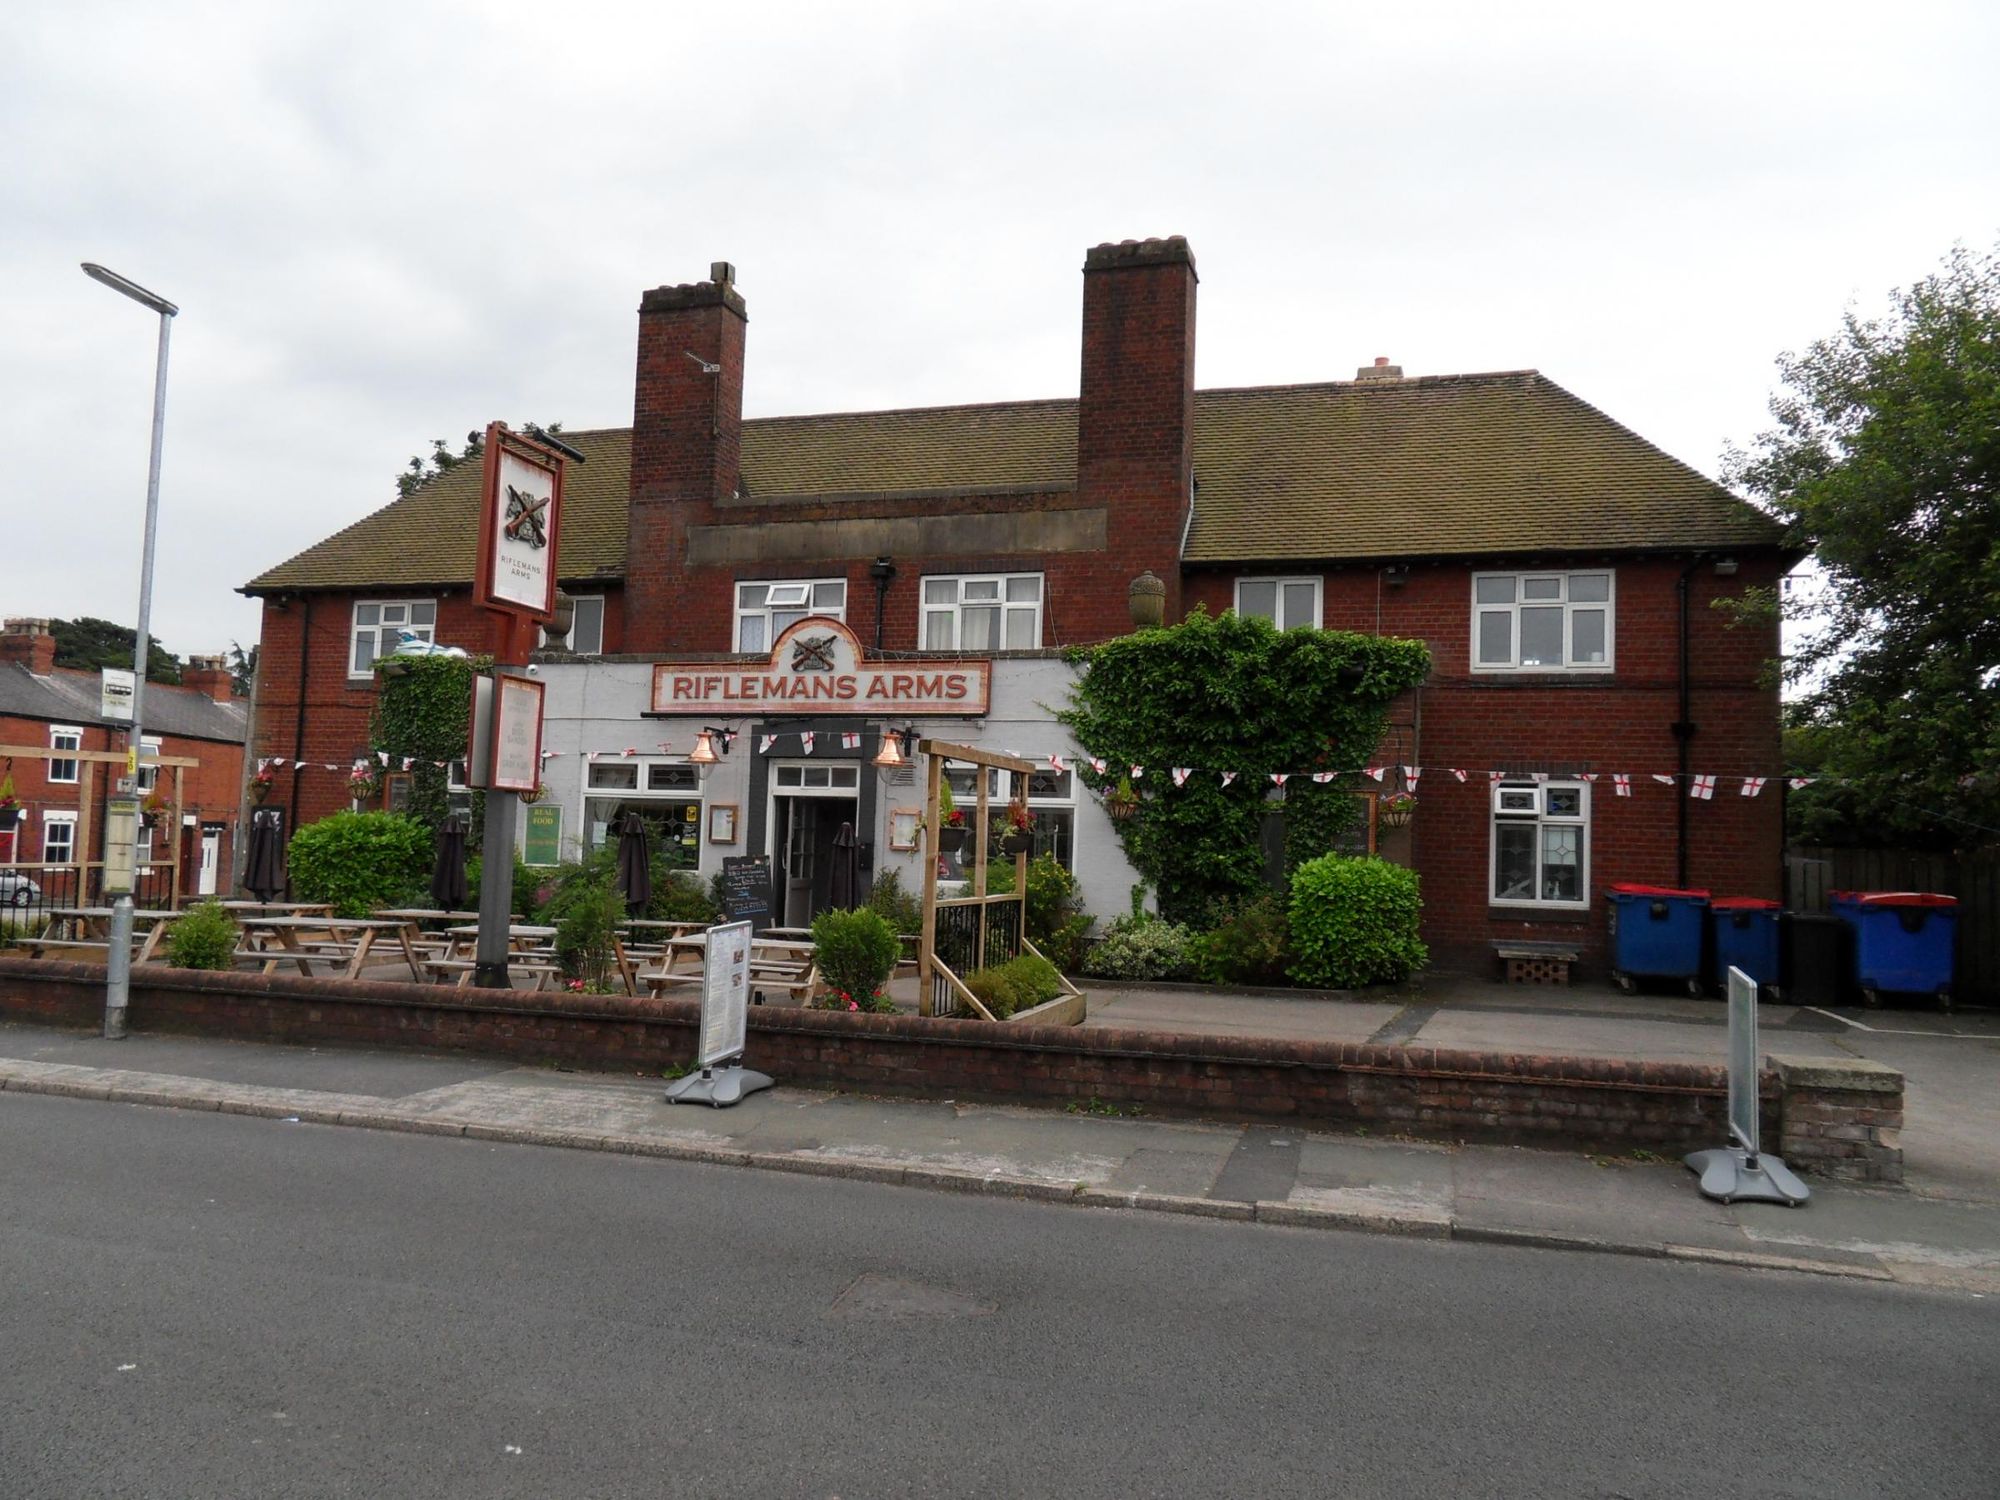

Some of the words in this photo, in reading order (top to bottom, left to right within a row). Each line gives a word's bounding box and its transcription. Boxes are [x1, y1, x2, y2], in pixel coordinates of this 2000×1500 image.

[501, 555, 541, 574] RIFLEMANS
[511, 568, 531, 580] ARMS
[672, 675, 857, 699] RIFLEMANS
[866, 675, 968, 699] ARMS
